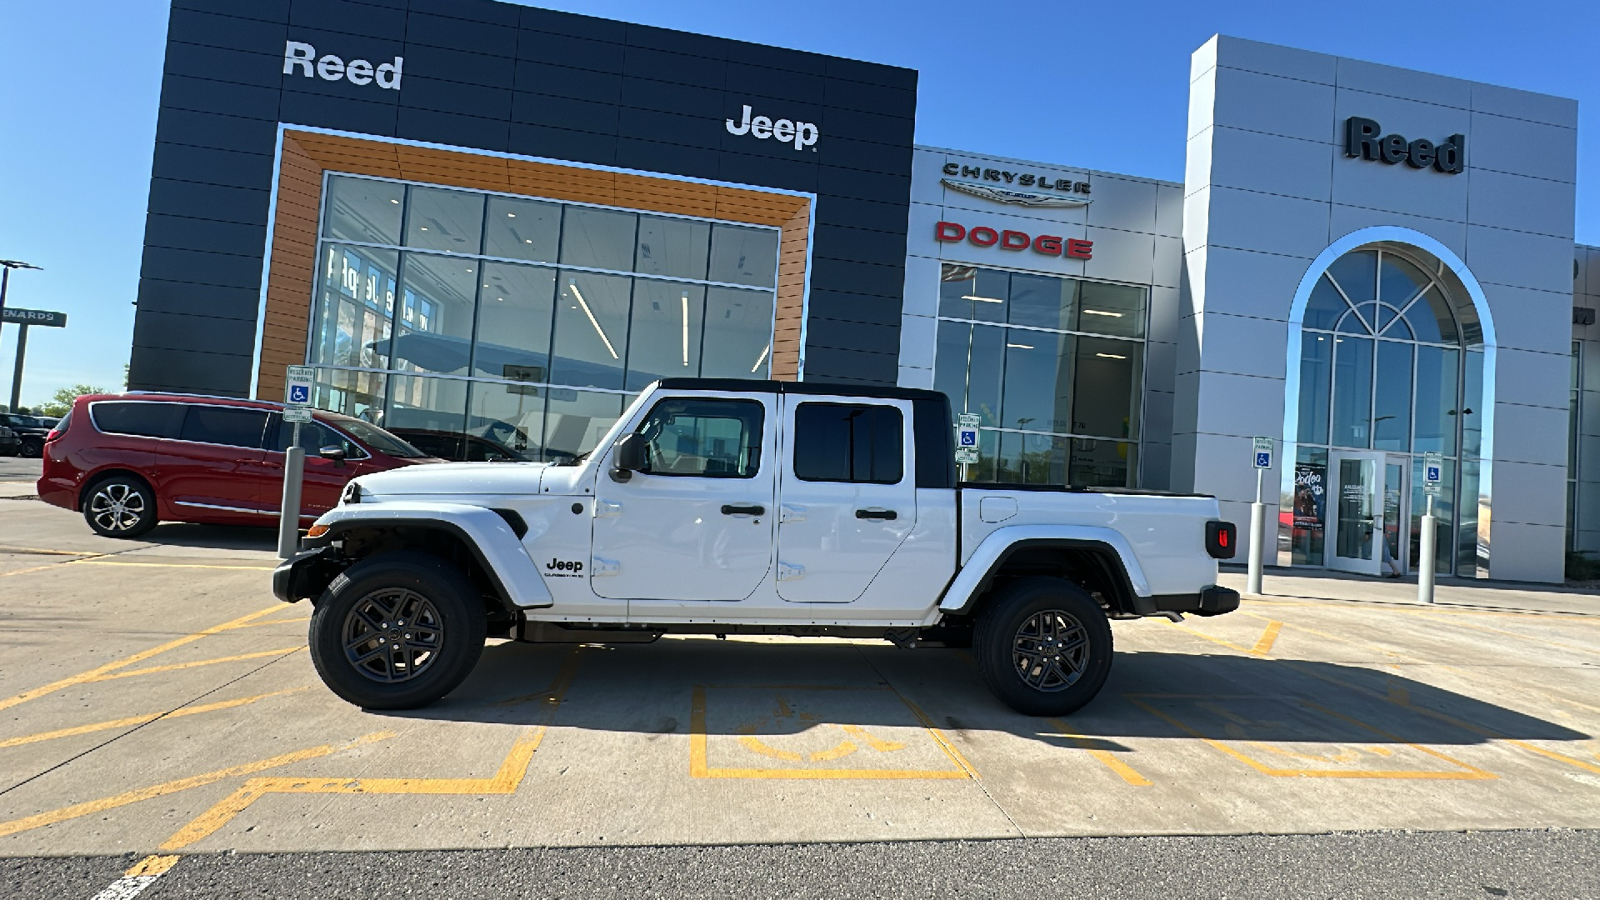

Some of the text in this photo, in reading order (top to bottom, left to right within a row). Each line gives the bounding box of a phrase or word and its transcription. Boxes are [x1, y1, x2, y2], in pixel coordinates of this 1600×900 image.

[283, 40, 403, 90] Reed
[726, 104, 819, 151] Jeep
[1346, 116, 1465, 174] Reed
[943, 163, 1092, 193] CHRYSLER
[936, 221, 1093, 260] DODGE
[2, 309, 54, 321] ENARDS
[546, 557, 583, 573] Jeep
